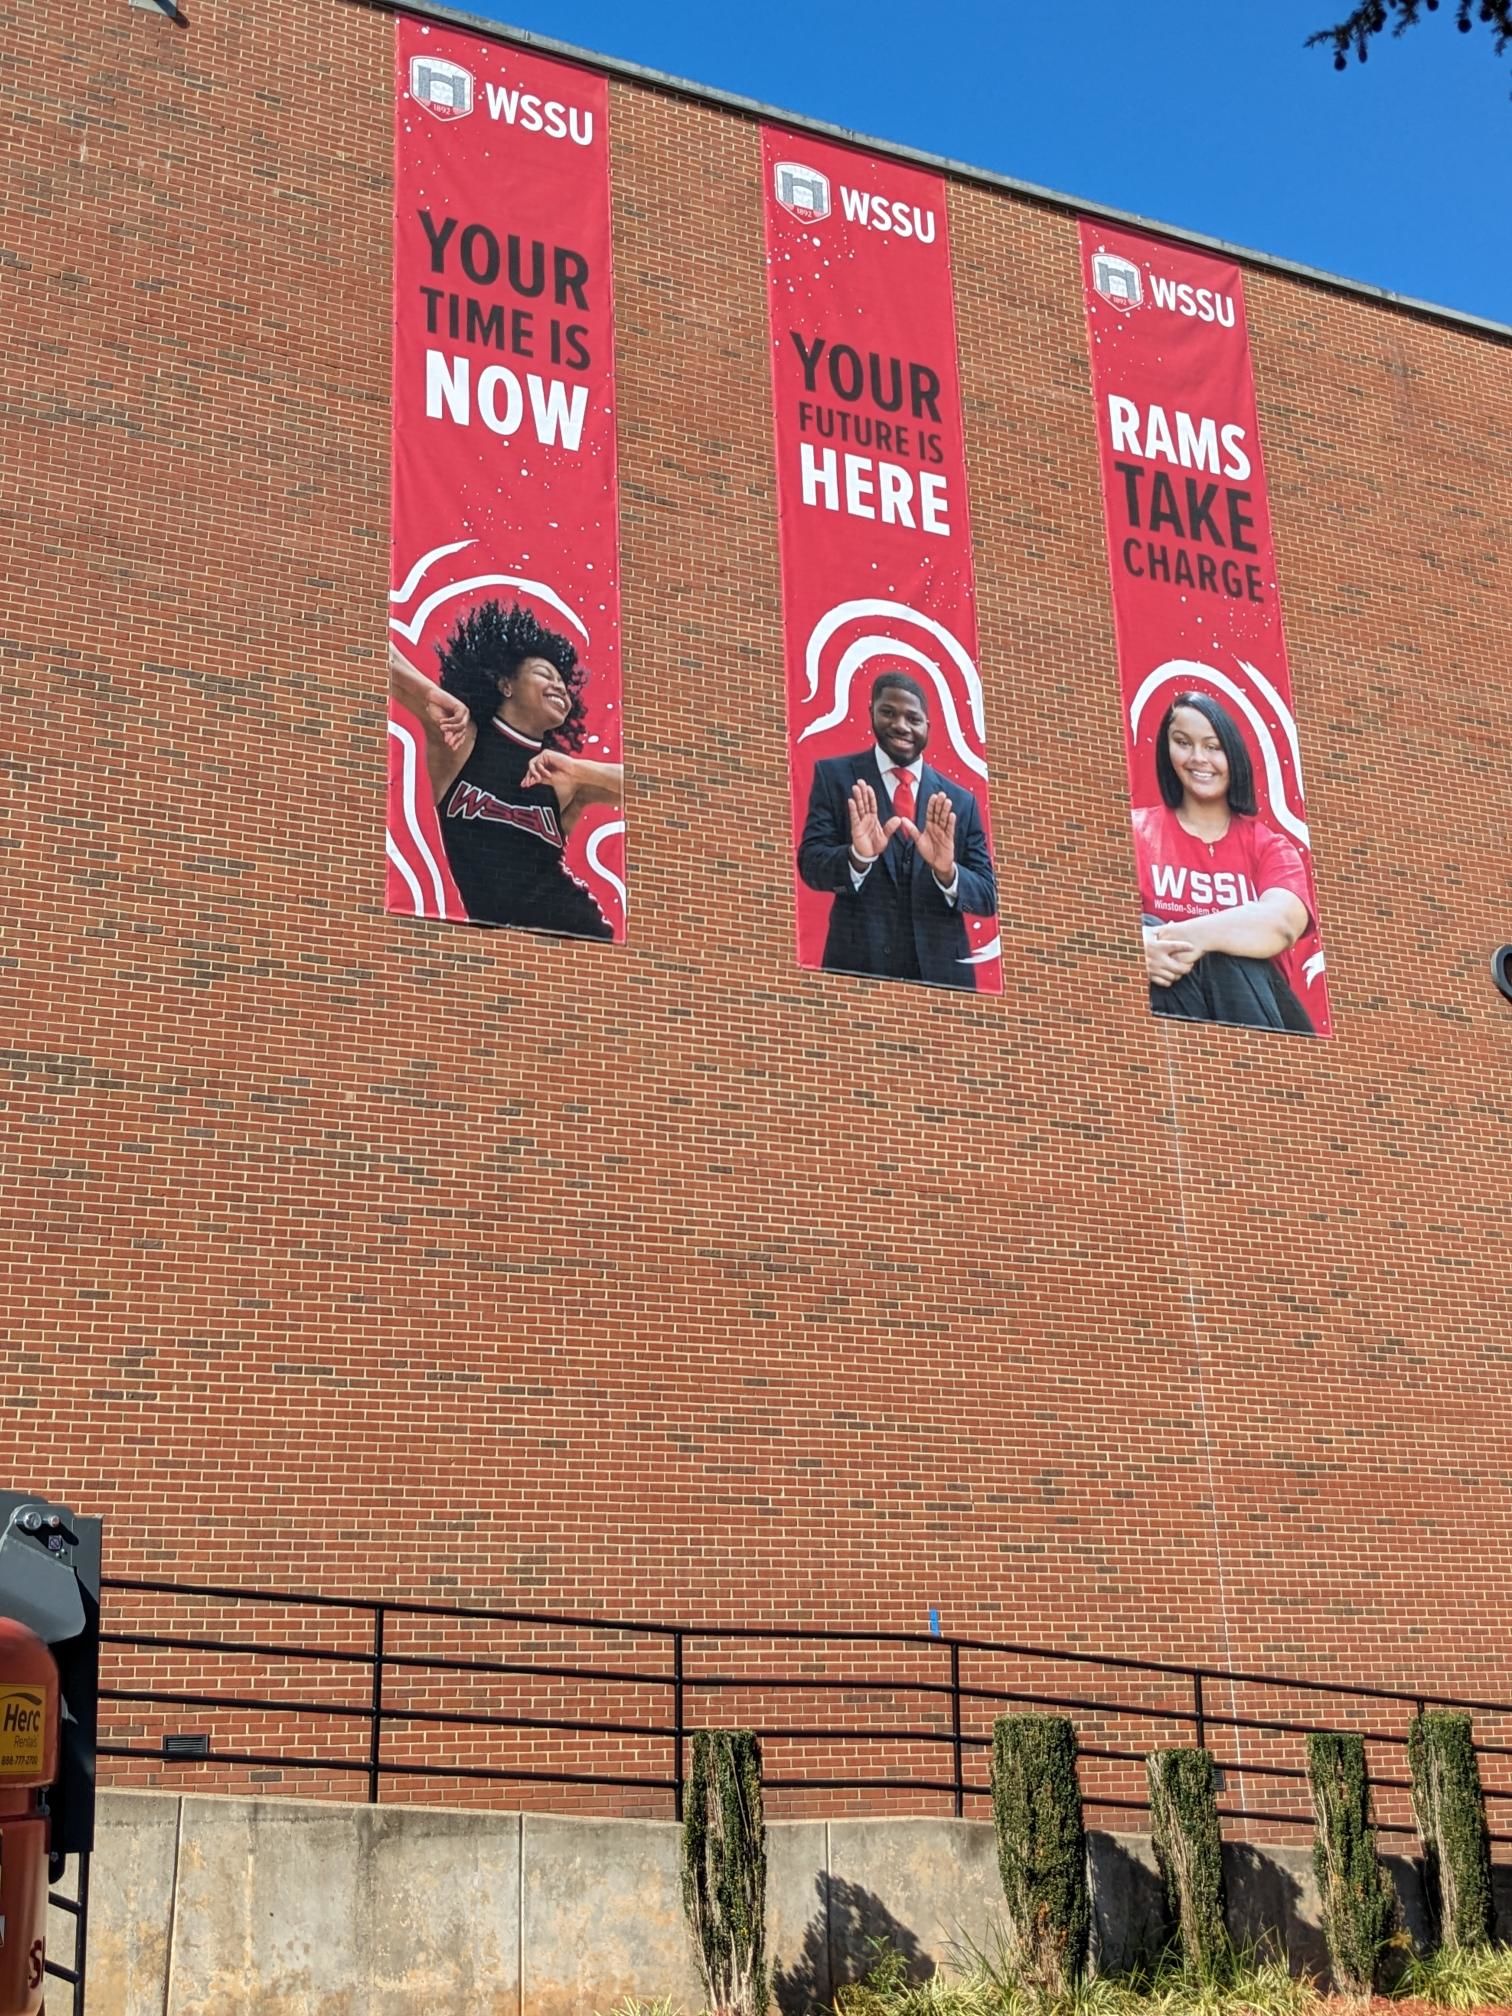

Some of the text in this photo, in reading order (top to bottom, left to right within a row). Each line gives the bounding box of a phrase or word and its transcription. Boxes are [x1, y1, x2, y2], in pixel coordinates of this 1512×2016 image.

[485, 82, 593, 146] WSSU
[839, 185, 935, 245] WSSU
[416, 209, 589, 311] YOUR
[419, 286, 591, 371] TIME IS
[1149, 274, 1235, 329] WSSU
[425, 349, 588, 452] NOW
[789, 331, 942, 424] YOUR
[799, 401, 944, 465] FUTURE IS
[1107, 393, 1251, 482] RAMS
[799, 442, 951, 536] HERE
[1114, 461, 1257, 554] TAKE
[1123, 537, 1265, 603] CHARGE
[447, 780, 563, 848] WSSU
[3, 1703, 41, 1732] Herc
